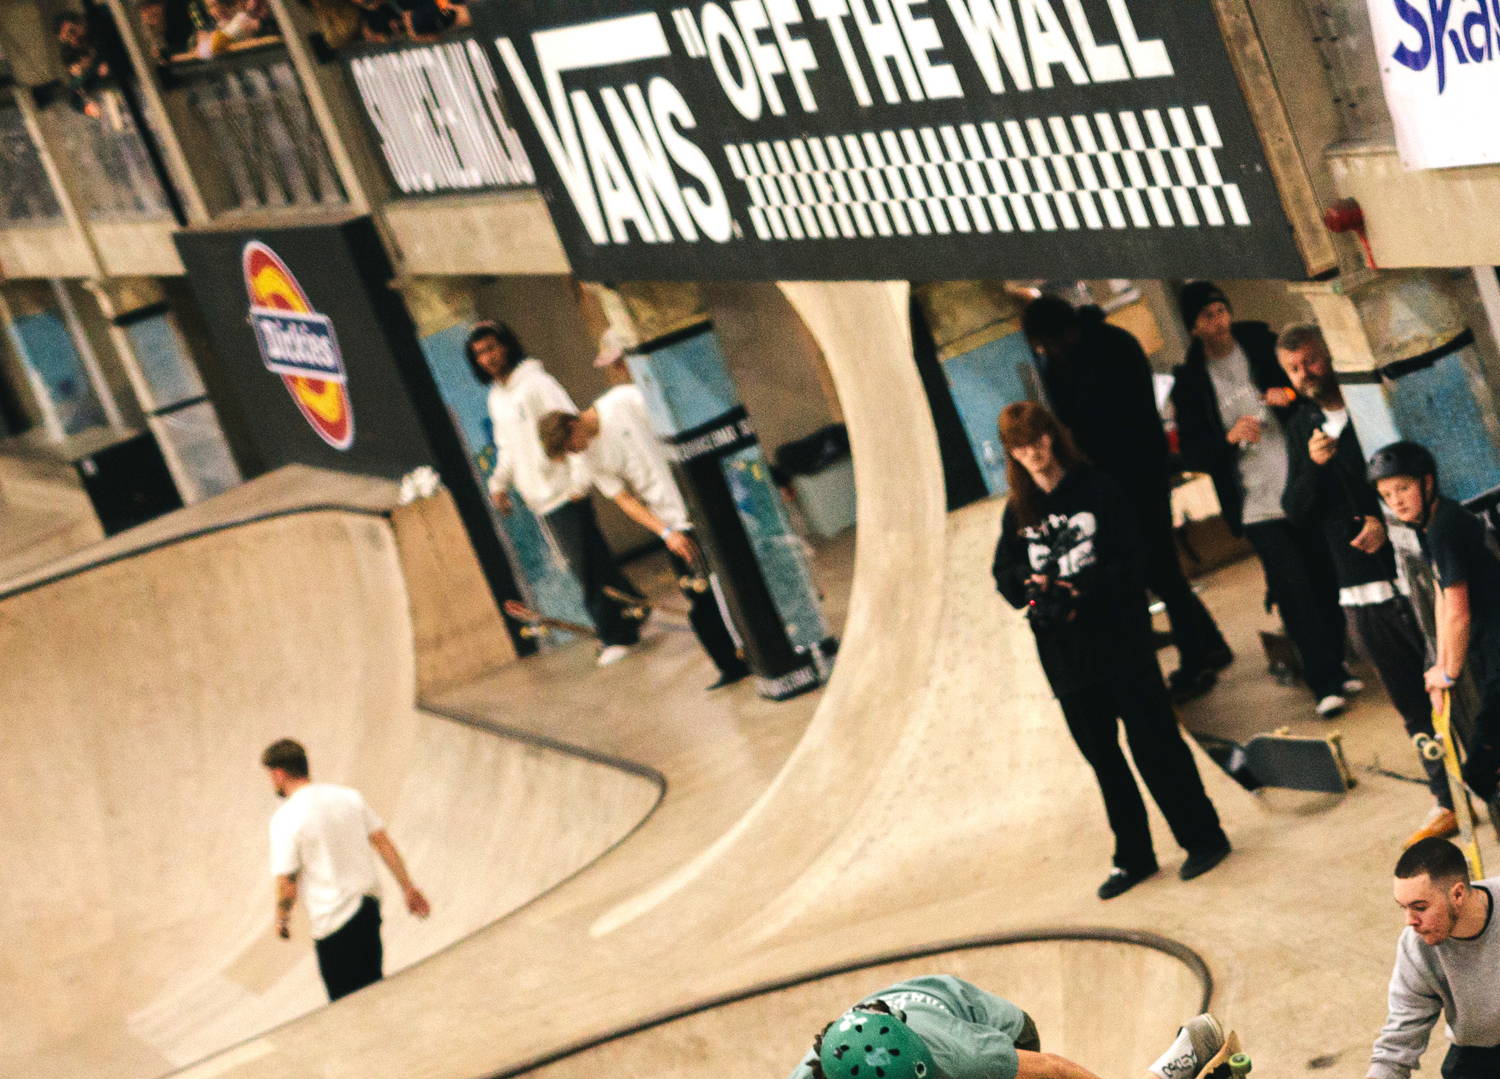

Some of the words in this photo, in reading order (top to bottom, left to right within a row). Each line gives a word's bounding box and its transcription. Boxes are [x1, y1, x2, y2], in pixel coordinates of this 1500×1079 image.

[495, 12, 732, 244] VANS
[813, 0, 965, 107] THE
[945, 0, 1175, 94] WALL
